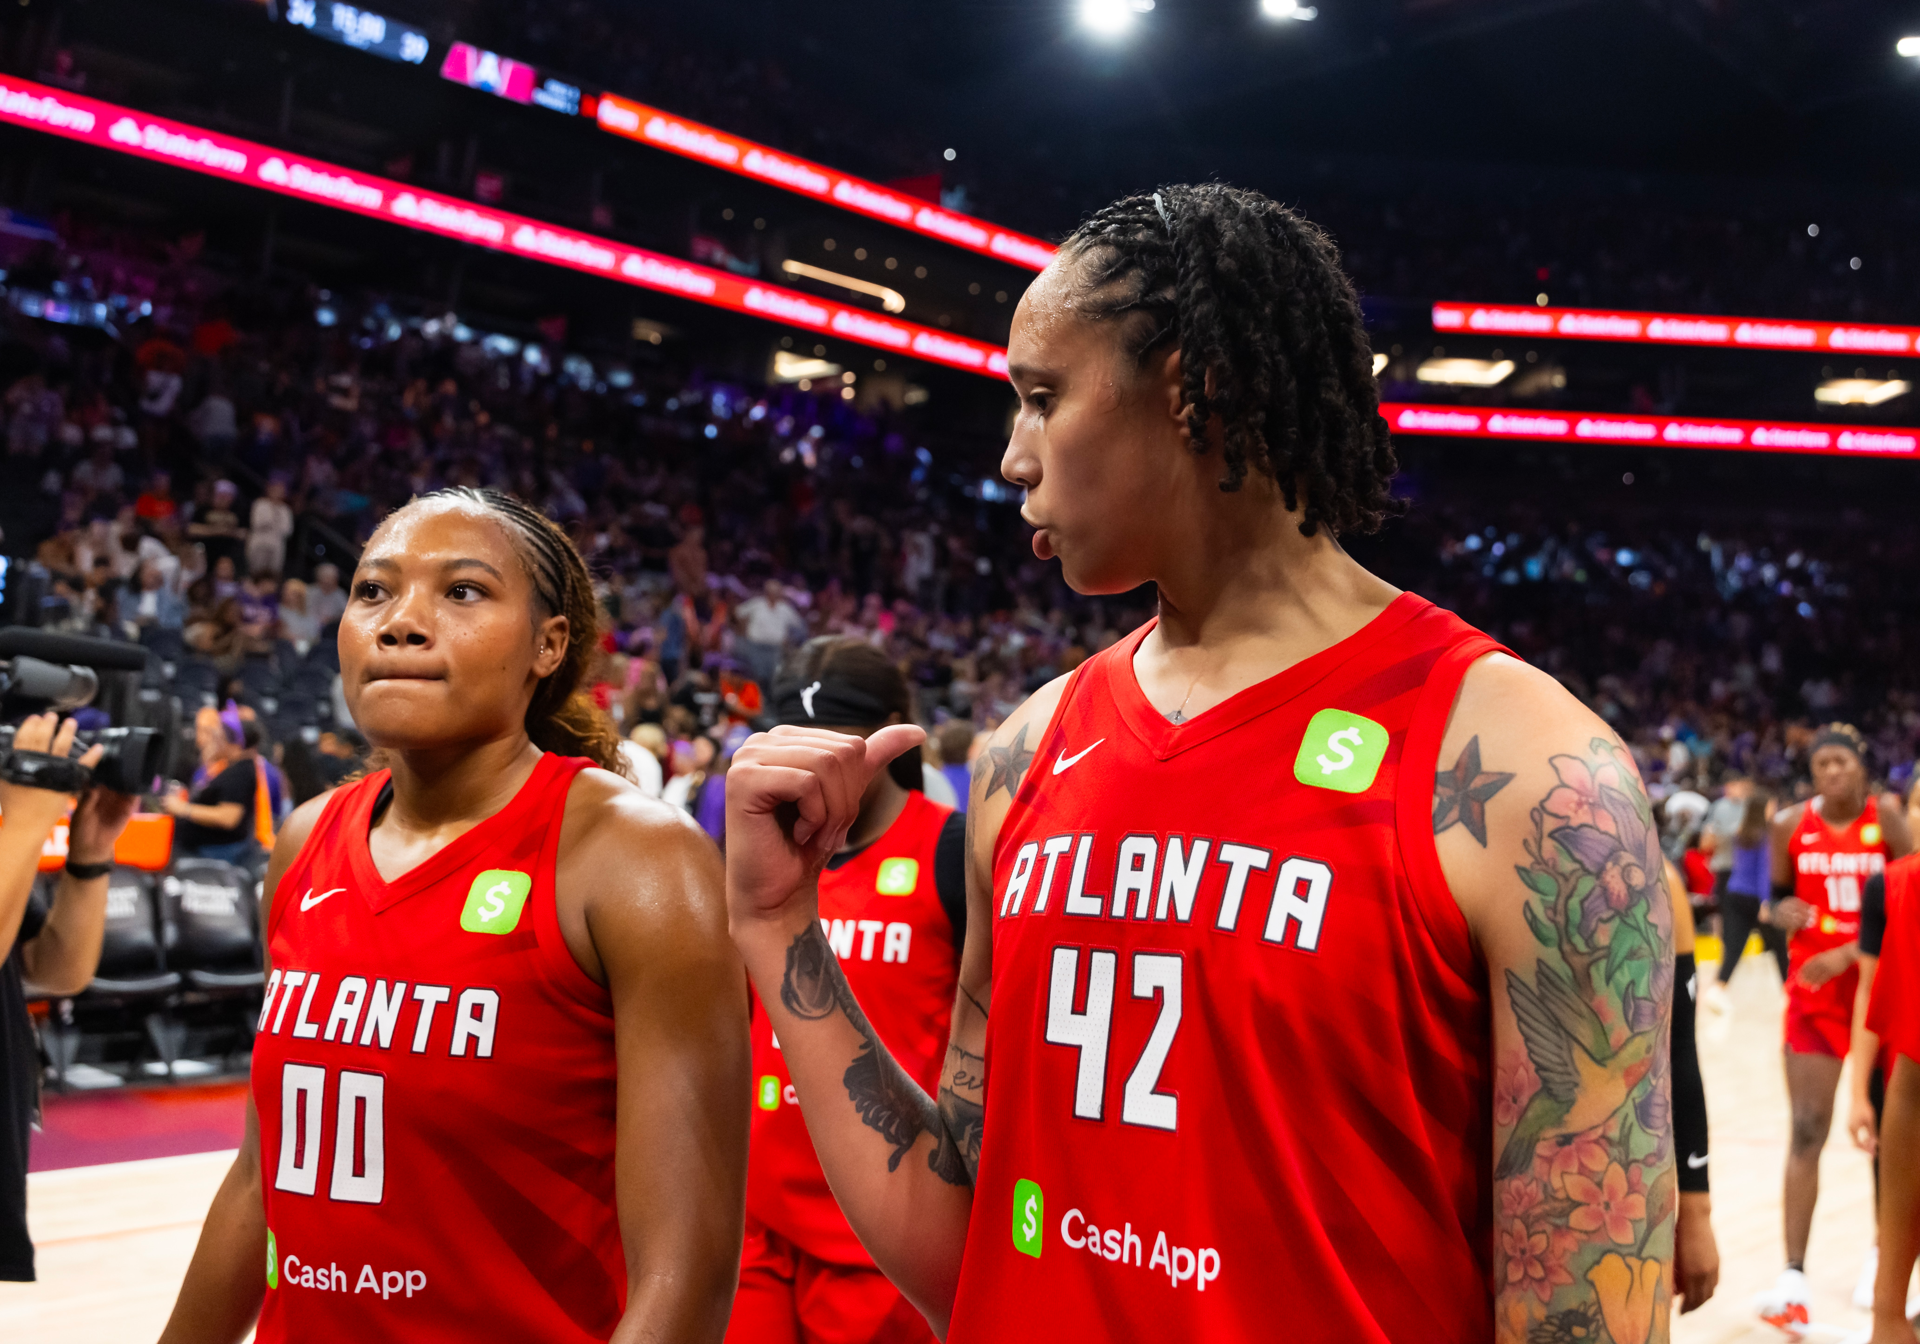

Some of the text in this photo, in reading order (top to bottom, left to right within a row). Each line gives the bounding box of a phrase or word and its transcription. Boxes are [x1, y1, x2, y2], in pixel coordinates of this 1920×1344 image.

[1001, 834, 1334, 955] ATLANTA
[1824, 876, 1861, 912] 10
[257, 969, 501, 1058] ATLANTA
[1045, 946, 1184, 1132] 42
[274, 1062, 385, 1204] 00
[283, 1254, 427, 1300] Cash App
[1060, 1208, 1143, 1267] Cash
[1149, 1230, 1221, 1292] App
